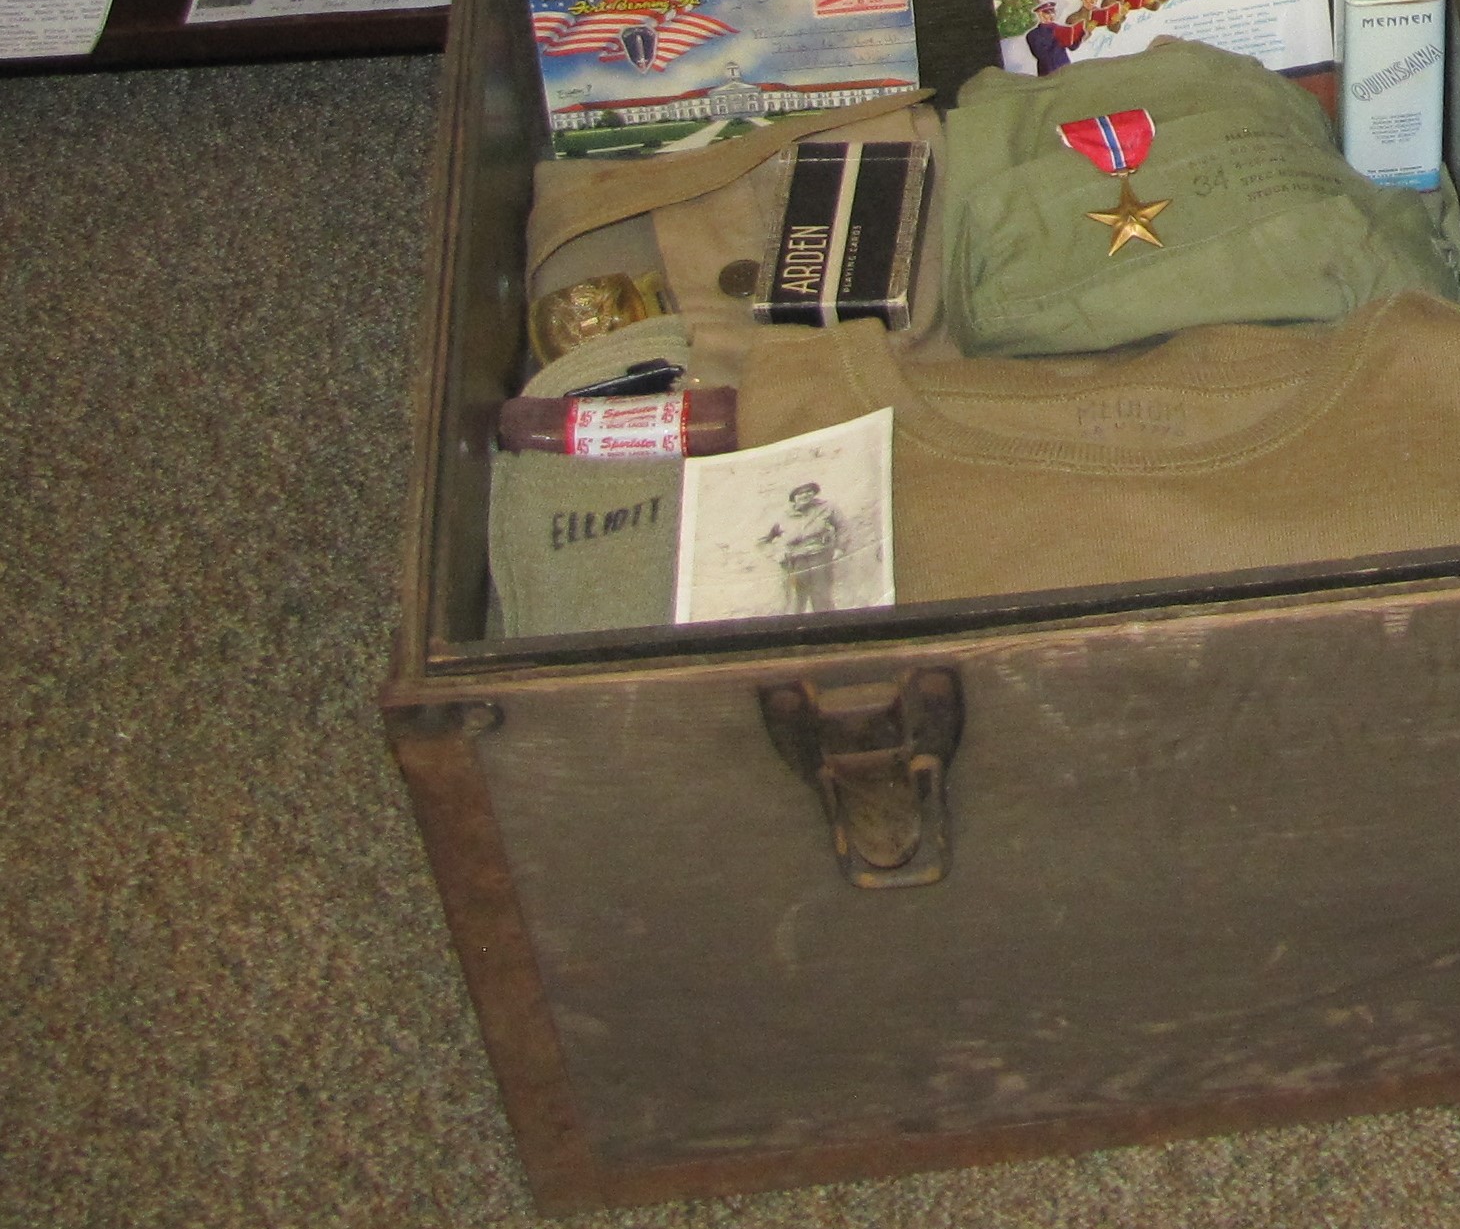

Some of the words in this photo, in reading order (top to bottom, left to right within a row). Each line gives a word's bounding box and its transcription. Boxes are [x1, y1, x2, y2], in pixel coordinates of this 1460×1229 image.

[1361, 13, 1433, 28] MENNEN
[1351, 44, 1443, 102] QUINSANA
[781, 225, 830, 294] ARDEN
[600, 436, 657, 451] Sportster
